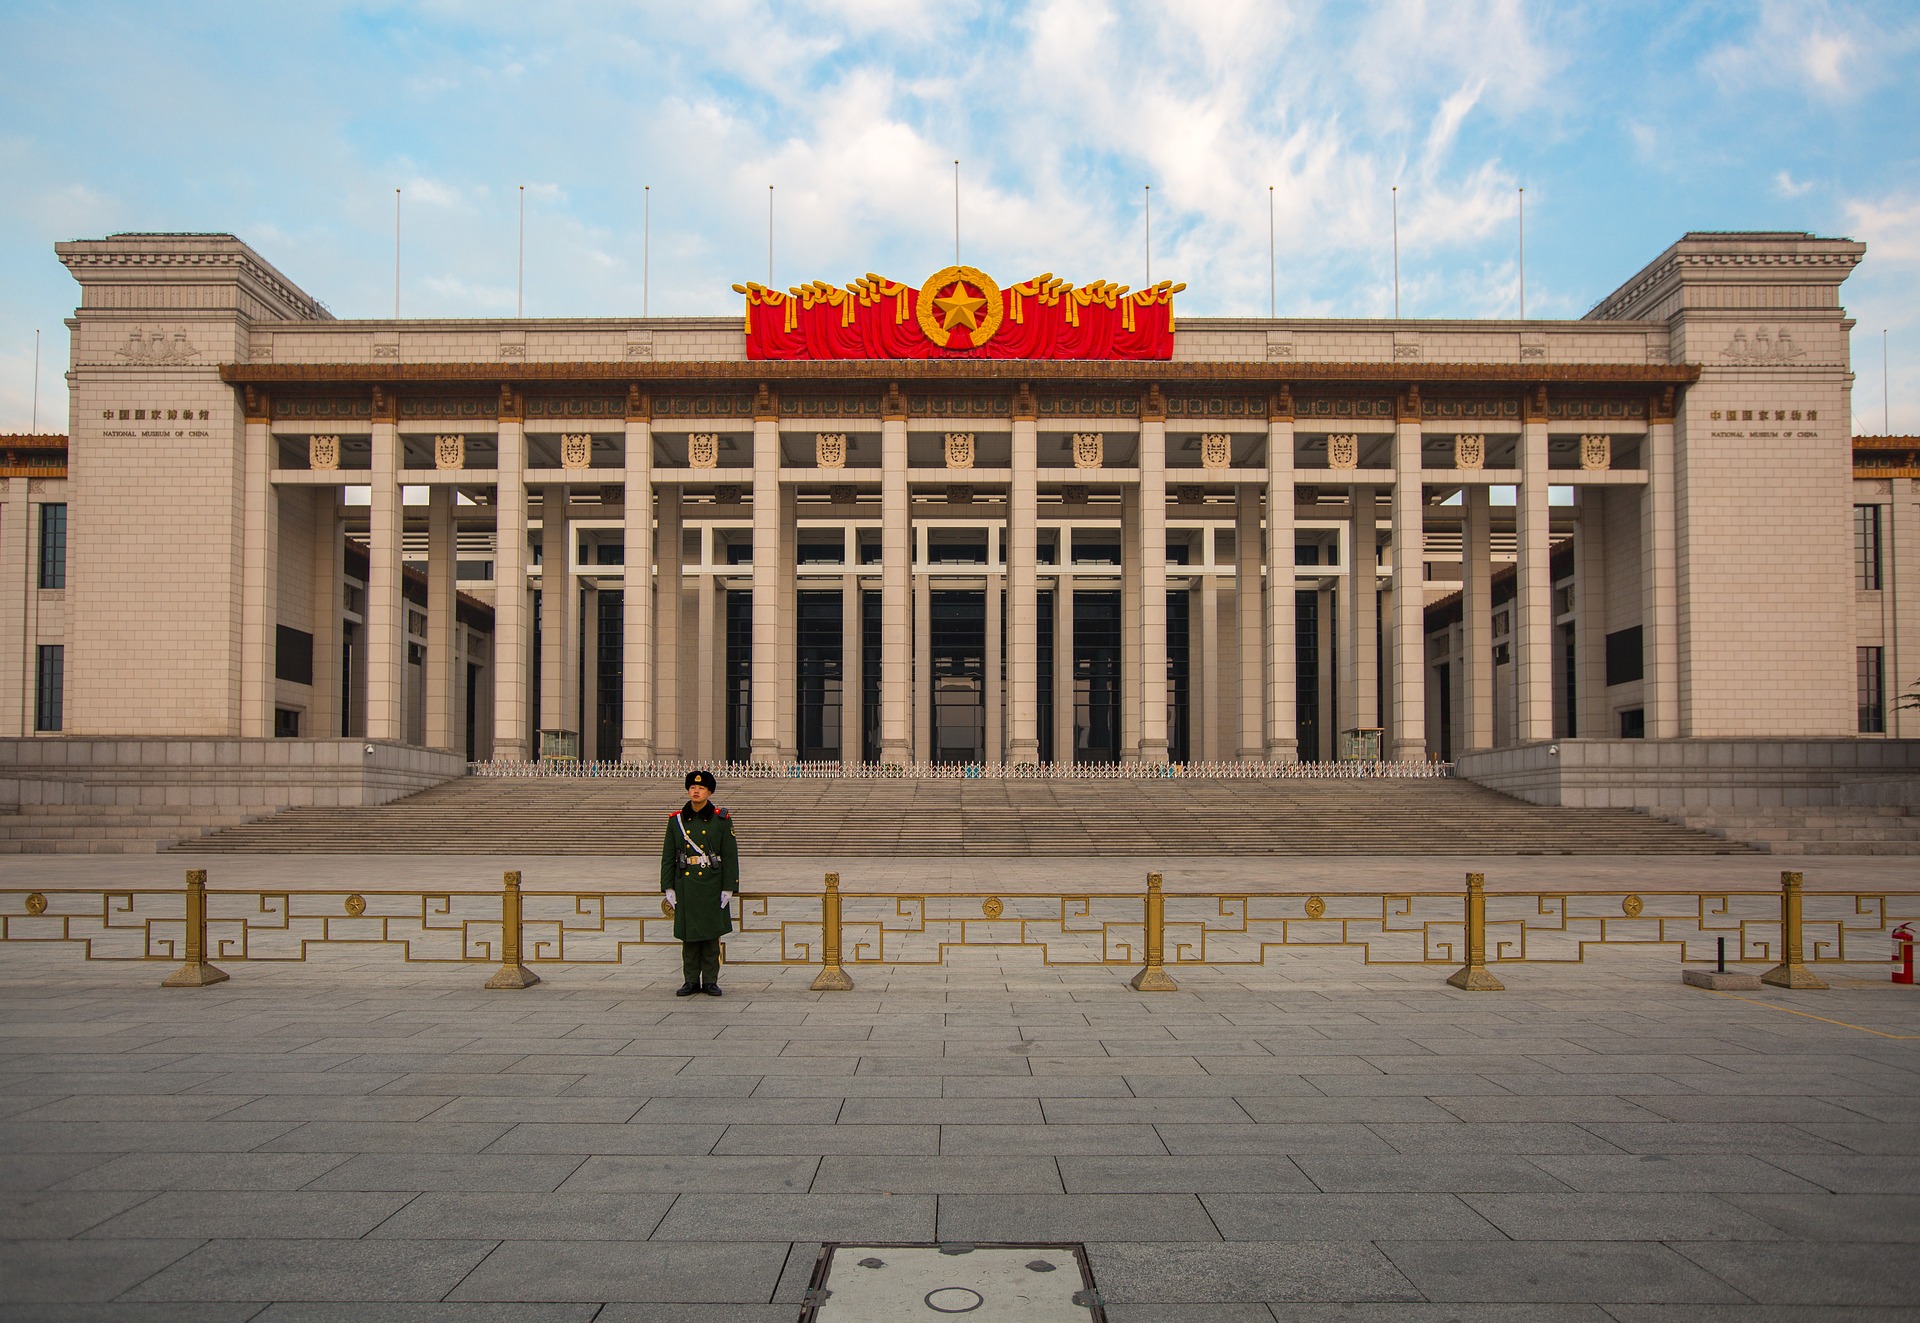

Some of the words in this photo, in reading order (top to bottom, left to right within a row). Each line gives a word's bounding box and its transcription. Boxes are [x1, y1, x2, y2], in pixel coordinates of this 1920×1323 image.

[103, 409, 210, 420] 中国国家博物馆
[1710, 410, 1817, 421] 中国国家博物馆
